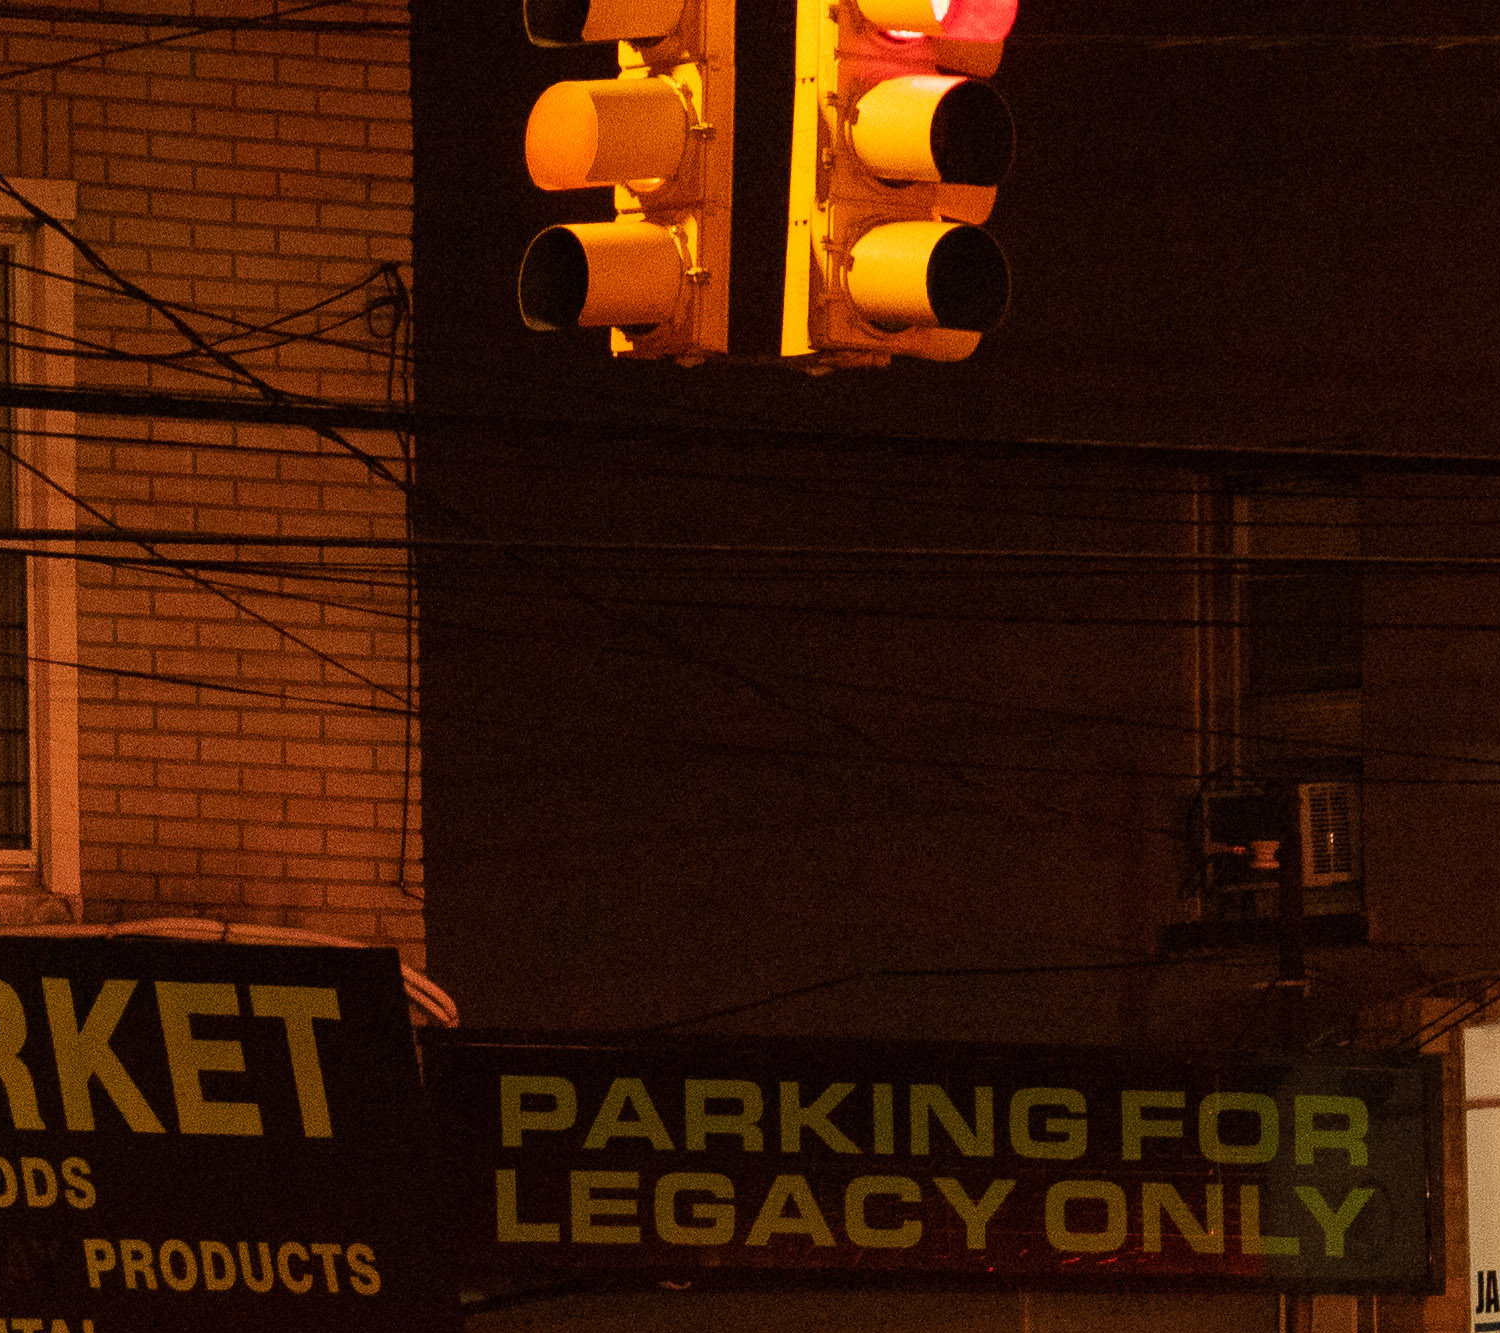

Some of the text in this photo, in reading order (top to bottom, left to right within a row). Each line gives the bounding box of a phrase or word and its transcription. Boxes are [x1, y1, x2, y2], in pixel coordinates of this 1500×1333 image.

[498, 1073, 1371, 1169] PARKING FOR
[494, 1166, 1376, 1259] LEGACY ONLY
[82, 1236, 383, 1298] PRODUCTS
